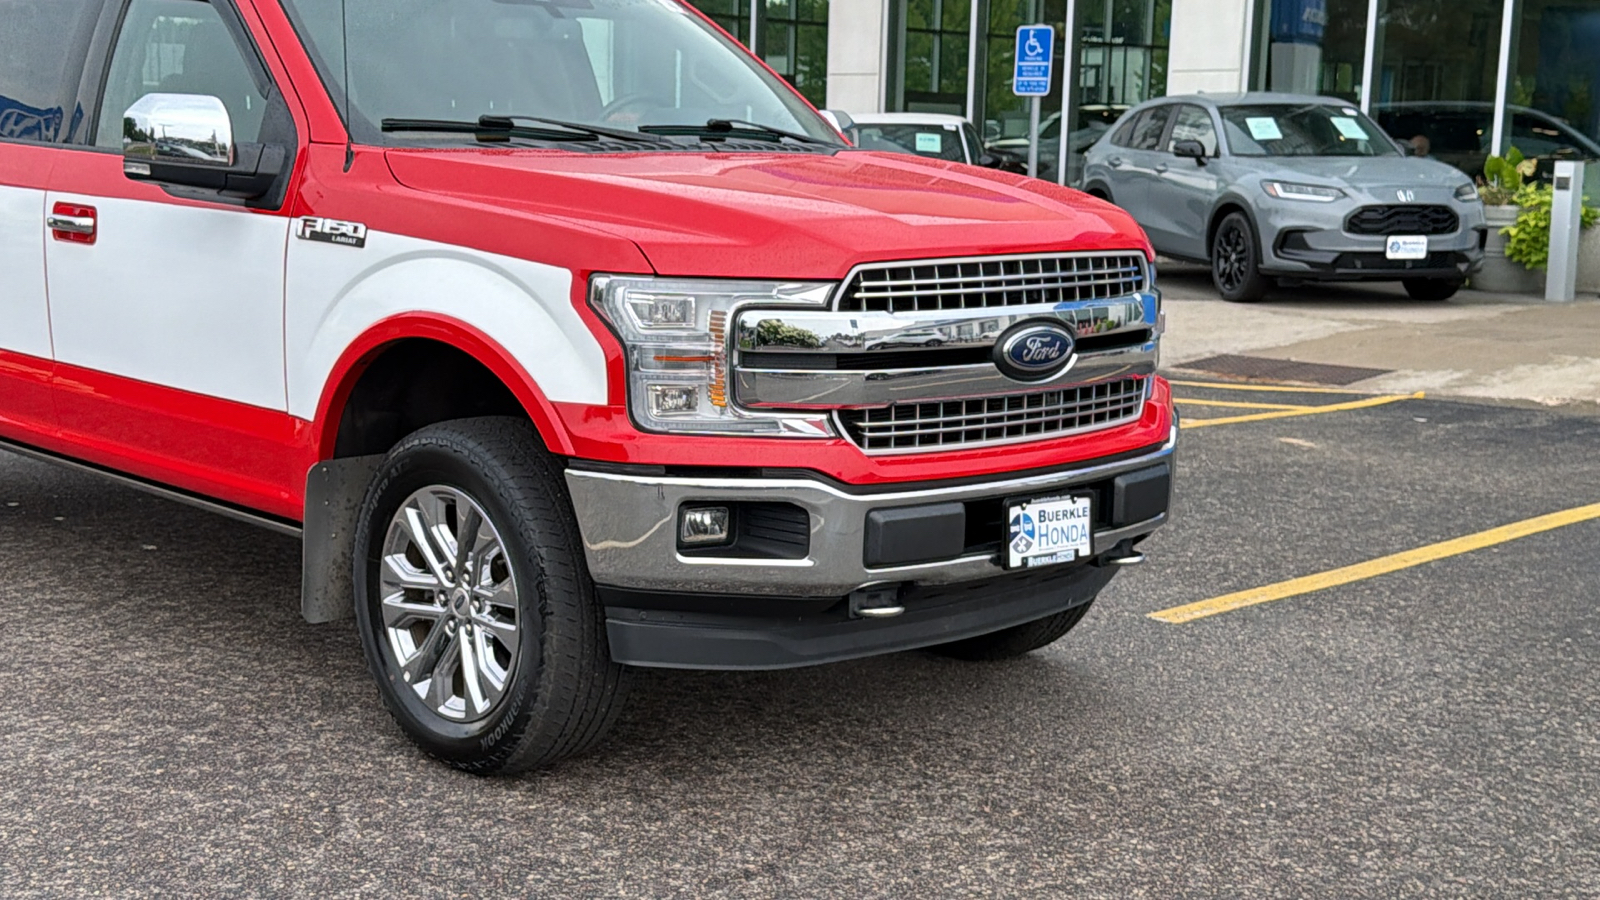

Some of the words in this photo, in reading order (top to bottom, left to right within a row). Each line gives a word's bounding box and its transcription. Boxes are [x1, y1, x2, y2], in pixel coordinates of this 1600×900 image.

[331, 235, 357, 245] LARIAT
[1022, 336, 1060, 362] Ford
[1038, 507, 1088, 523] BUERKLE
[1038, 523, 1088, 547] HONDA
